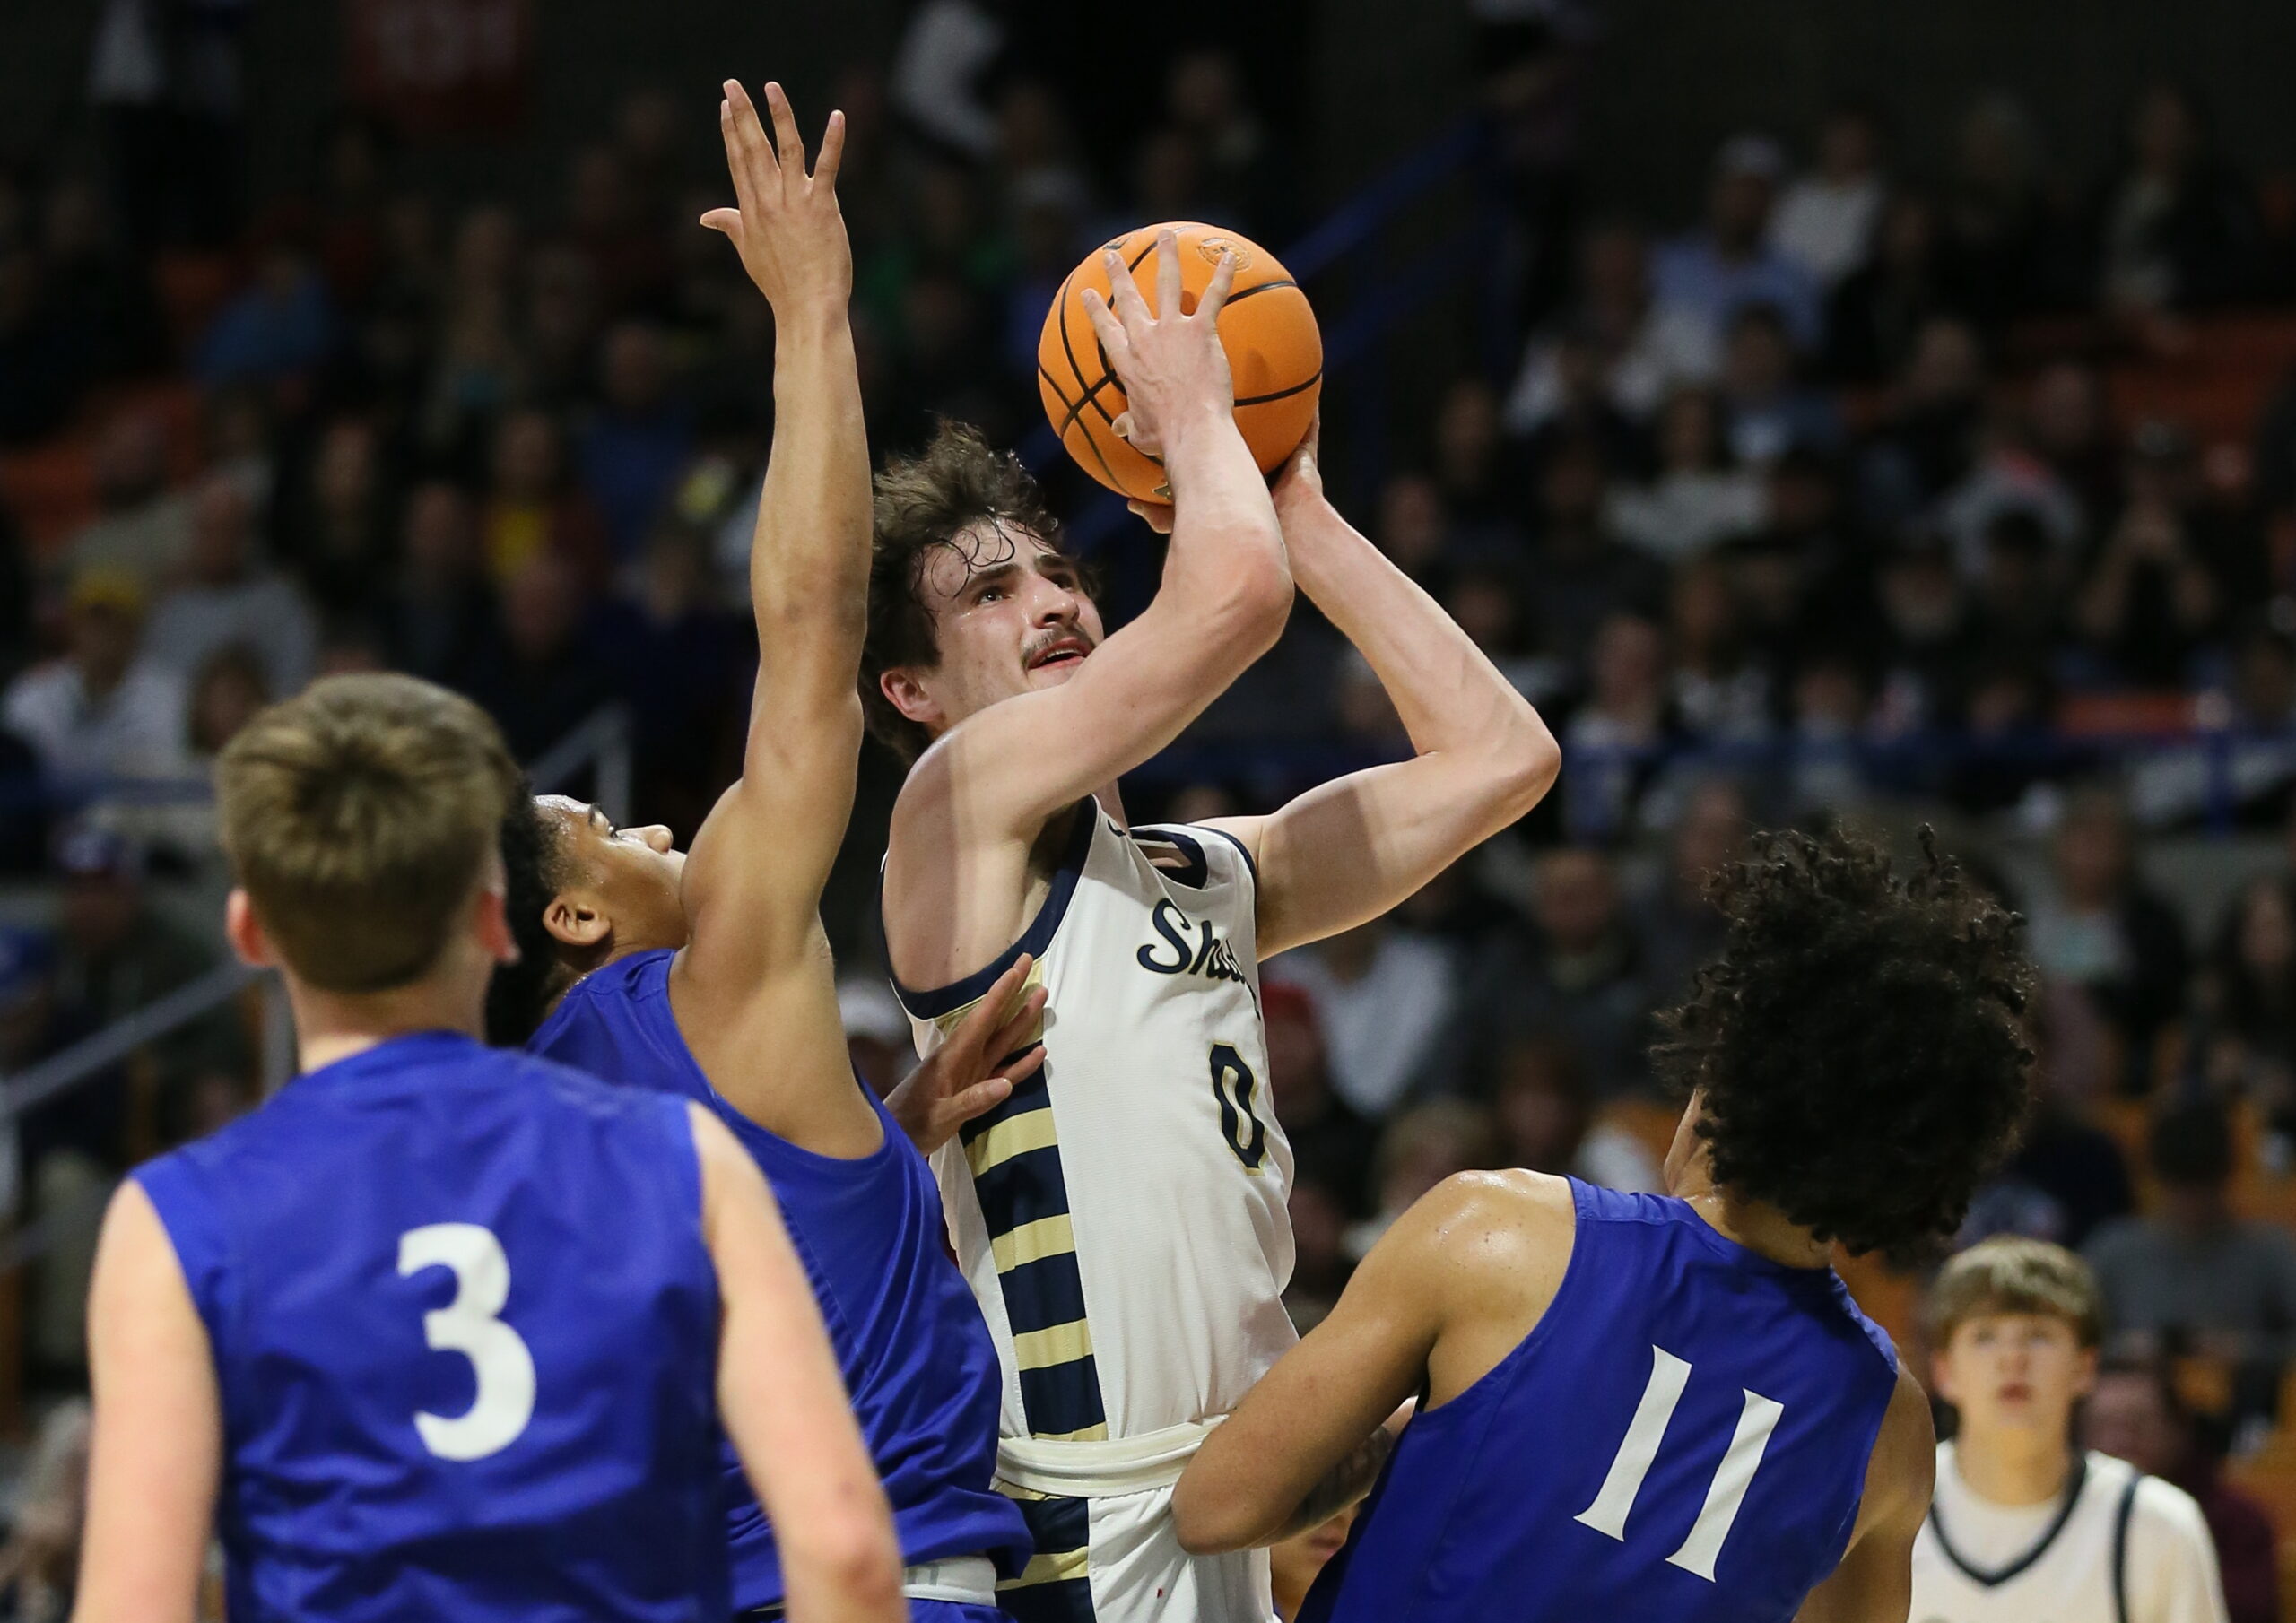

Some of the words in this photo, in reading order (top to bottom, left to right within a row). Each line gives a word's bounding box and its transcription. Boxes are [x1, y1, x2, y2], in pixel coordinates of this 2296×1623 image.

[1208, 1040, 1265, 1176] 0
[396, 1222, 537, 1462] 3
[1572, 1343, 1785, 1584] 11
